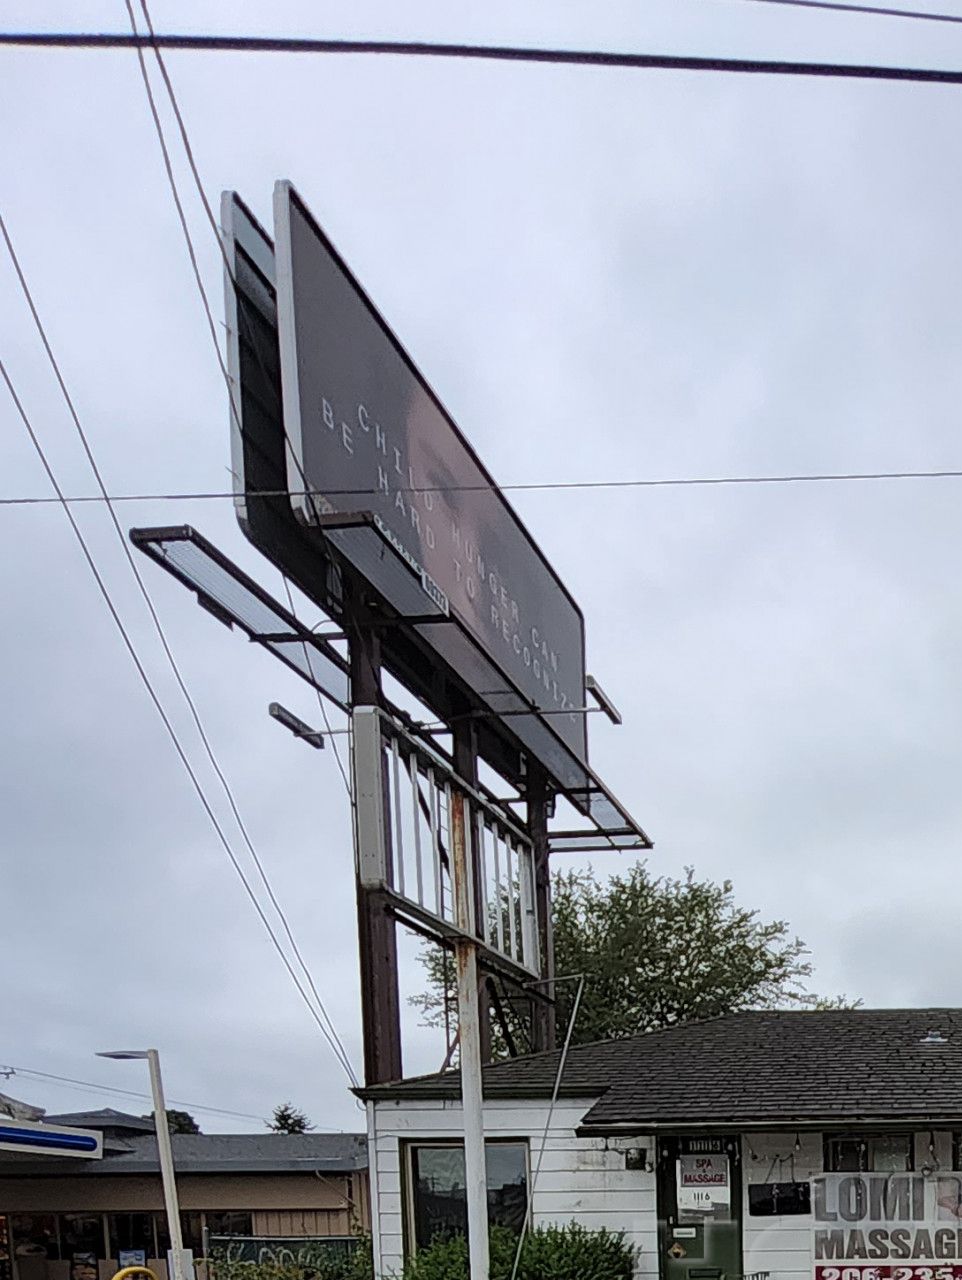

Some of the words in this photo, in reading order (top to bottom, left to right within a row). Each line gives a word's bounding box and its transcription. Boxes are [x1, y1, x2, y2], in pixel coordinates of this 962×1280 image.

[322, 397, 353, 456] BE
[379, 466, 434, 549] HARD
[454, 559, 475, 599] TO
[358, 404, 433, 511] CHILD
[452, 522, 519, 624] HUNGER
[532, 628, 557, 673] CAN
[684, 1173, 725, 1184] MASSAGE
[695, 1158, 713, 1168] SPA
[814, 1177, 925, 1221] LOMI
